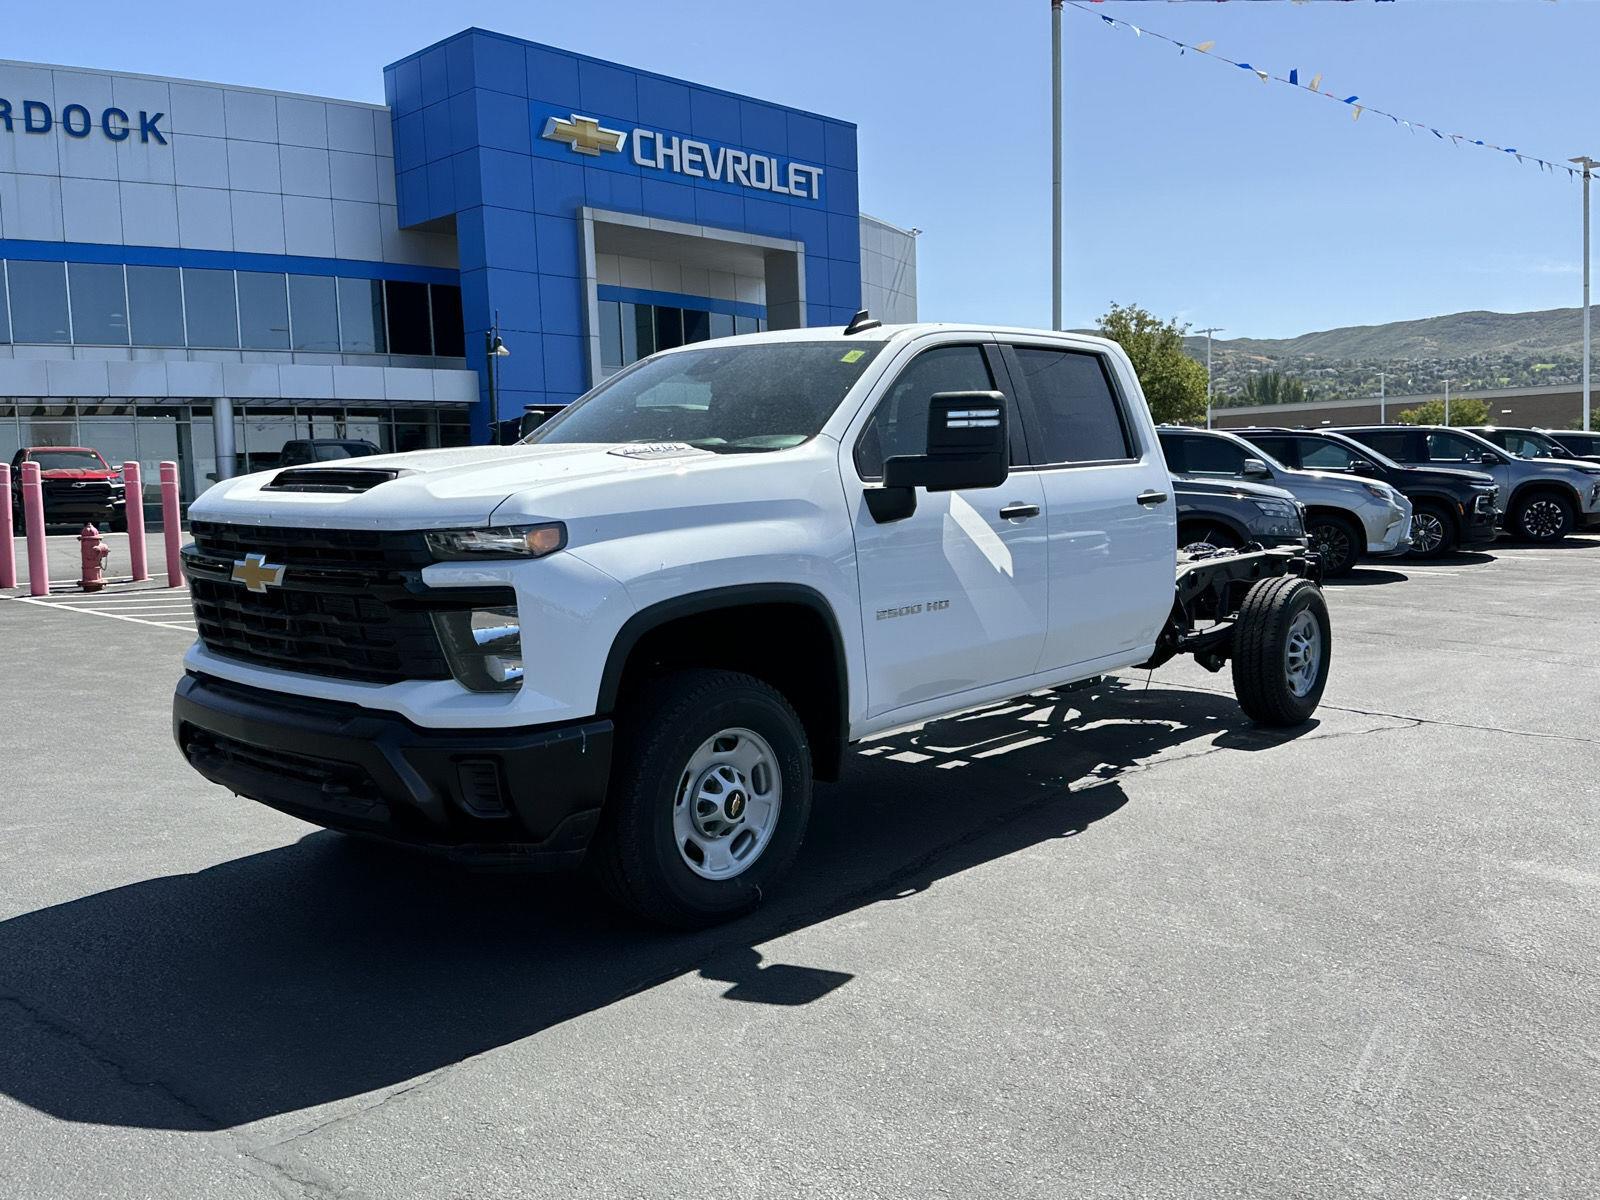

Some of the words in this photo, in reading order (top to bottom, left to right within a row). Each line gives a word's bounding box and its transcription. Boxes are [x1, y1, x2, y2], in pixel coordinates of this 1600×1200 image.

[632, 127, 824, 200] CHEVROLET
[876, 604, 922, 621] 2500
[926, 600, 950, 612] HD
